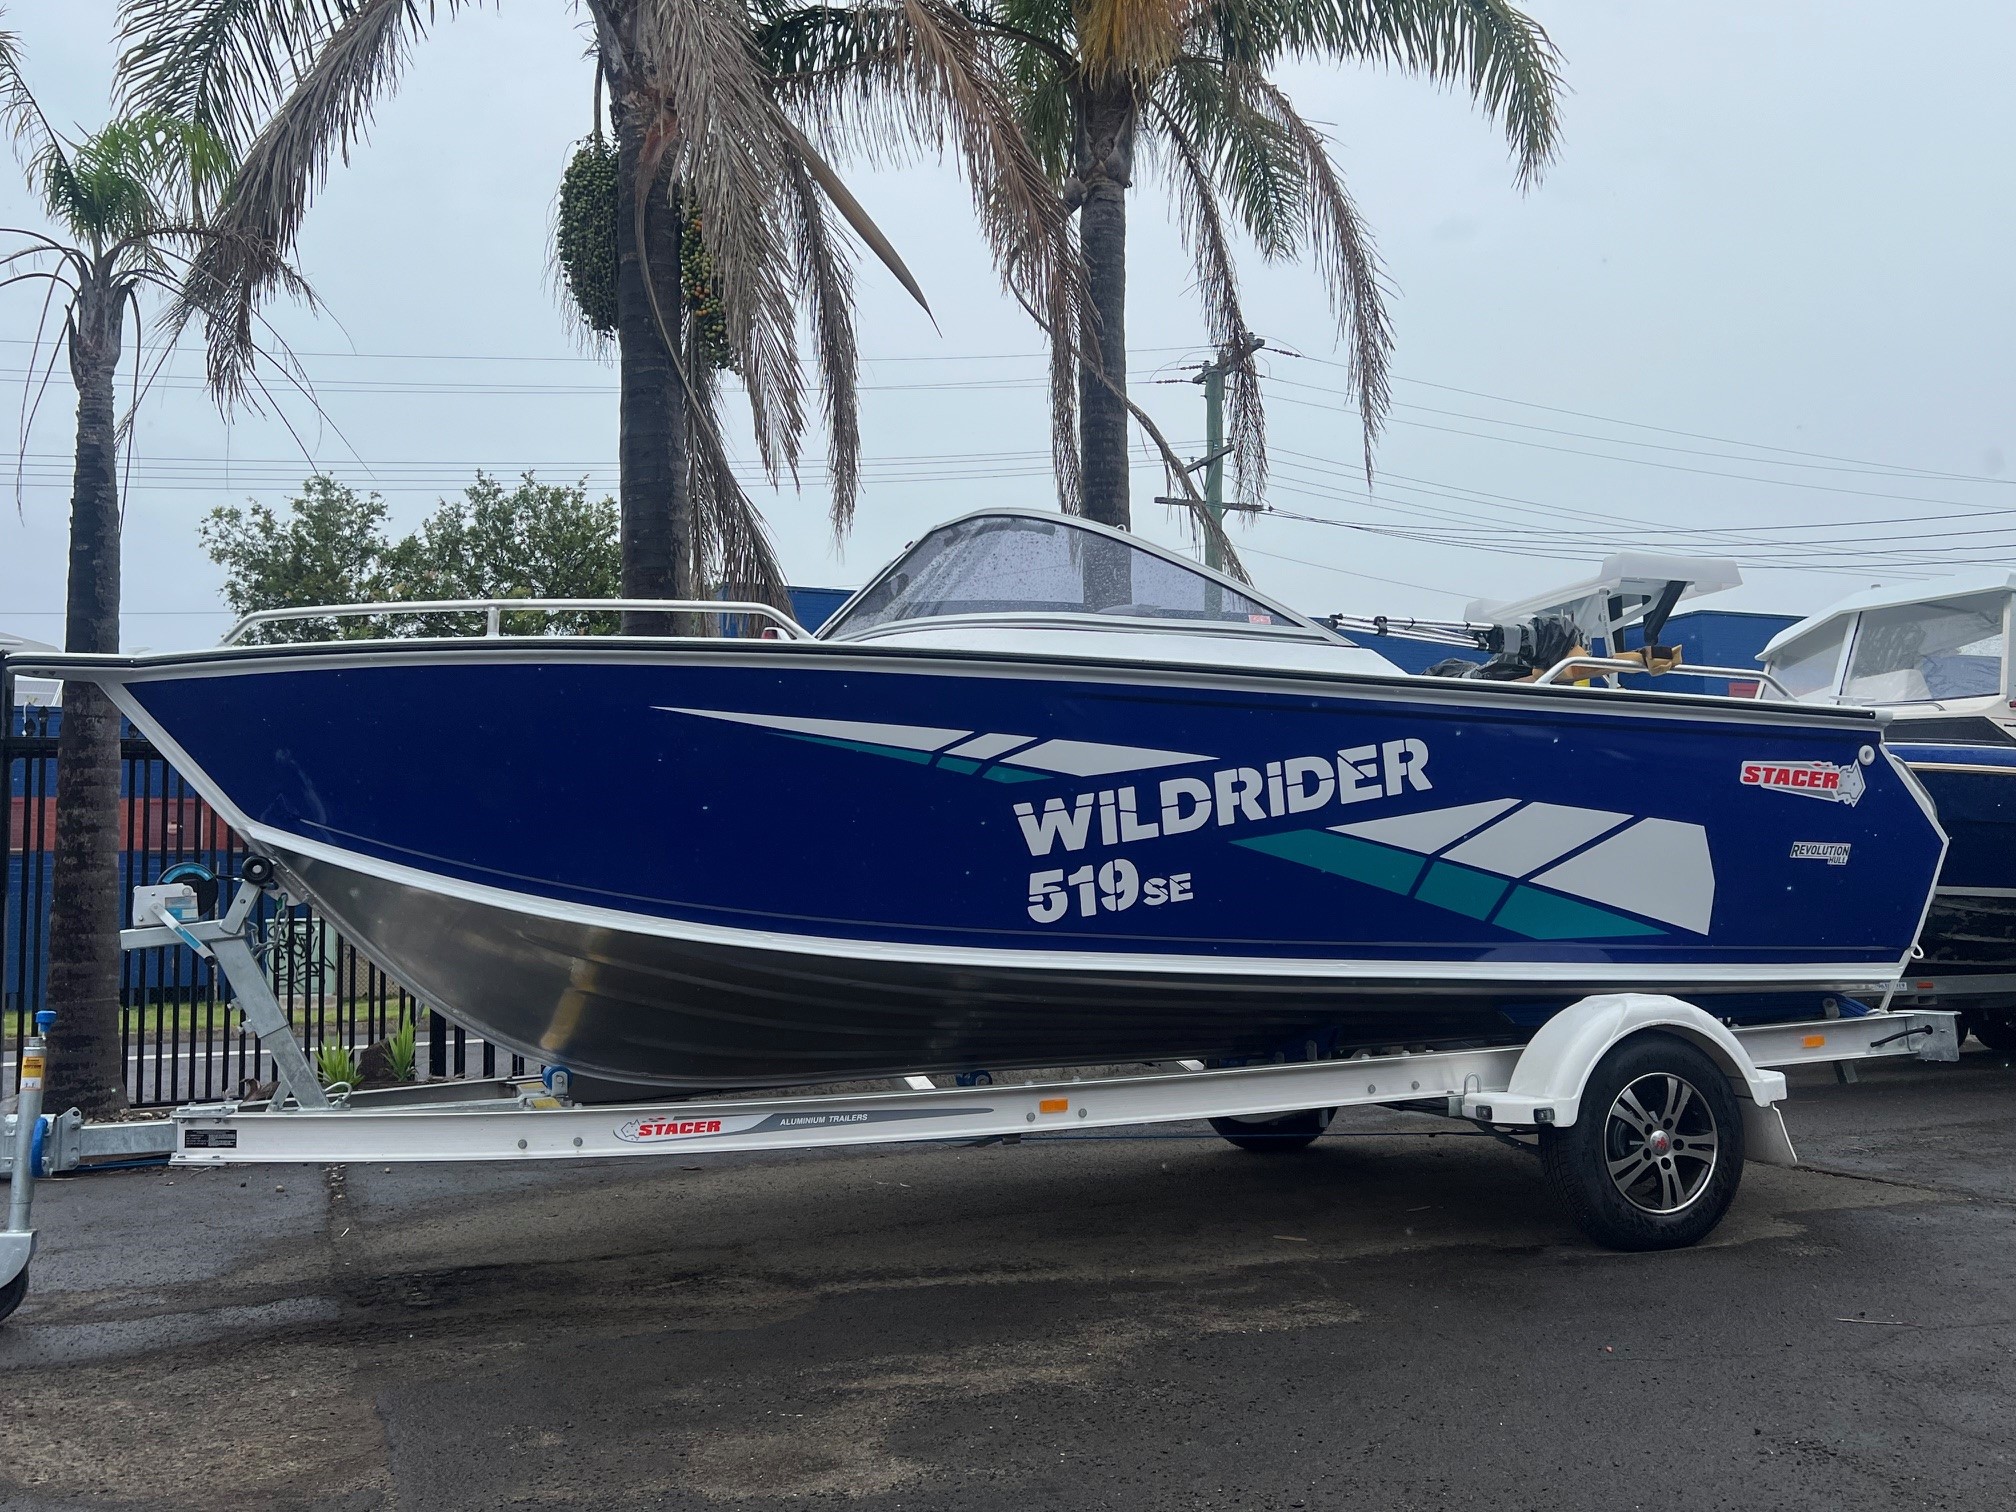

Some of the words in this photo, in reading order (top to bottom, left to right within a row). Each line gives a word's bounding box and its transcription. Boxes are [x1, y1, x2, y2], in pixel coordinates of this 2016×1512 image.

[1743, 766, 1840, 789] STACER
[1790, 844, 1850, 857] REVOLUTION
[1828, 856, 1847, 864] HULL
[780, 1116, 826, 1126] ALUMINIUM
[829, 1113, 868, 1123] TRAILERS
[638, 1120, 721, 1136] STACER
